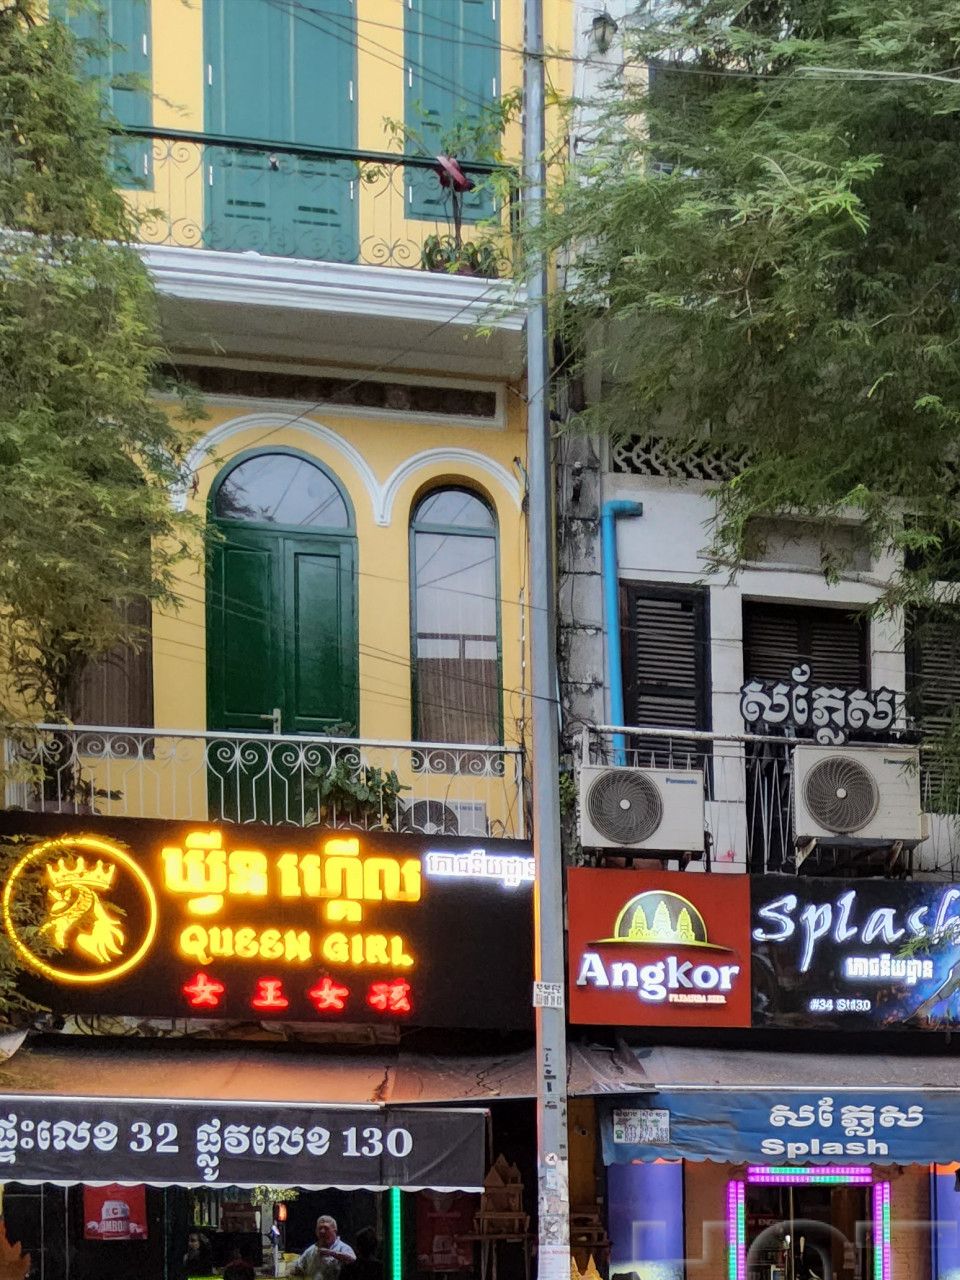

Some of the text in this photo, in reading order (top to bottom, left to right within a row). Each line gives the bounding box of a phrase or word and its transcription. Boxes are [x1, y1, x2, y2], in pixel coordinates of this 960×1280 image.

[665, 777, 698, 785] Panasonic
[180, 925, 414, 968] QUEEN GIRL
[576, 953, 740, 1001] Angkor
[810, 998, 834, 1011] #34
[130, 1122, 179, 1153] 32
[342, 1127, 413, 1157] 130
[760, 1138, 889, 1159] Splash
